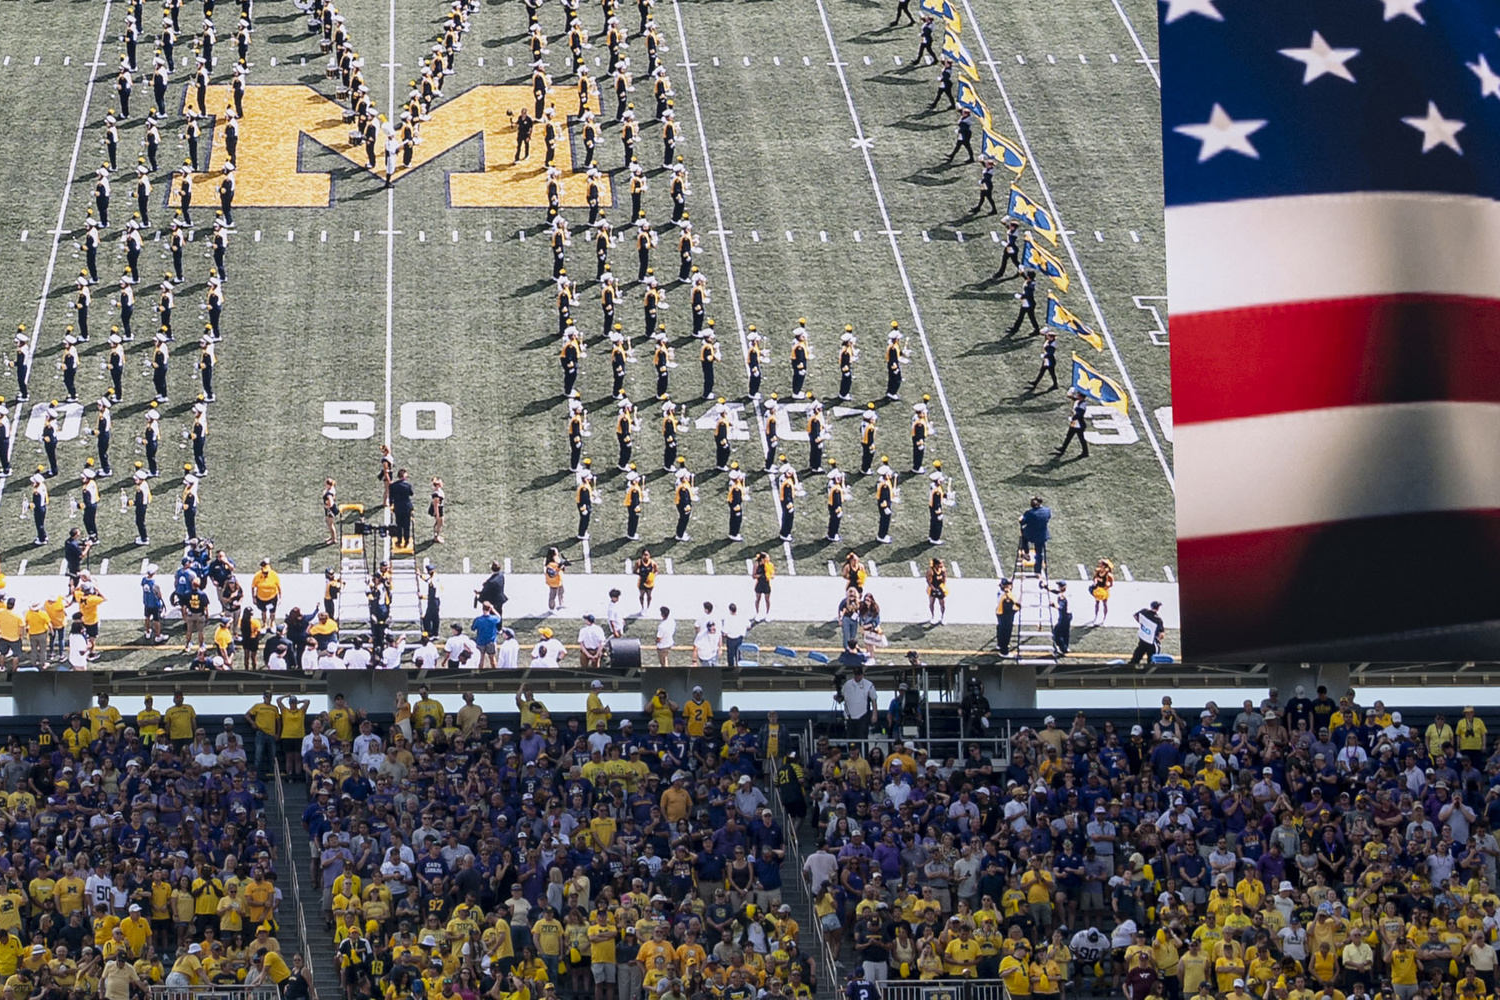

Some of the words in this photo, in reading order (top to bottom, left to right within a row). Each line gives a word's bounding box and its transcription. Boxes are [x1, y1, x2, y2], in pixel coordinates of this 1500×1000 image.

[984, 137, 1006, 155] M
[1077, 367, 1102, 398] M
[321, 401, 453, 440] 50
[695, 709, 702, 721] 2
[39, 734, 50, 745] 10
[75, 734, 79, 745] 1
[1368, 734, 1375, 747] 7
[622, 744, 626, 755] 1
[677, 744, 684, 758] 7
[779, 769, 789, 784] 21
[133, 838, 140, 853] 7
[97, 886, 111, 901] 50
[429, 900, 444, 911] 97
[631, 898, 643, 906] AIL
[540, 925, 558, 933] 2023
[1468, 924, 1478, 933] M
[1079, 948, 1098, 960] 90
